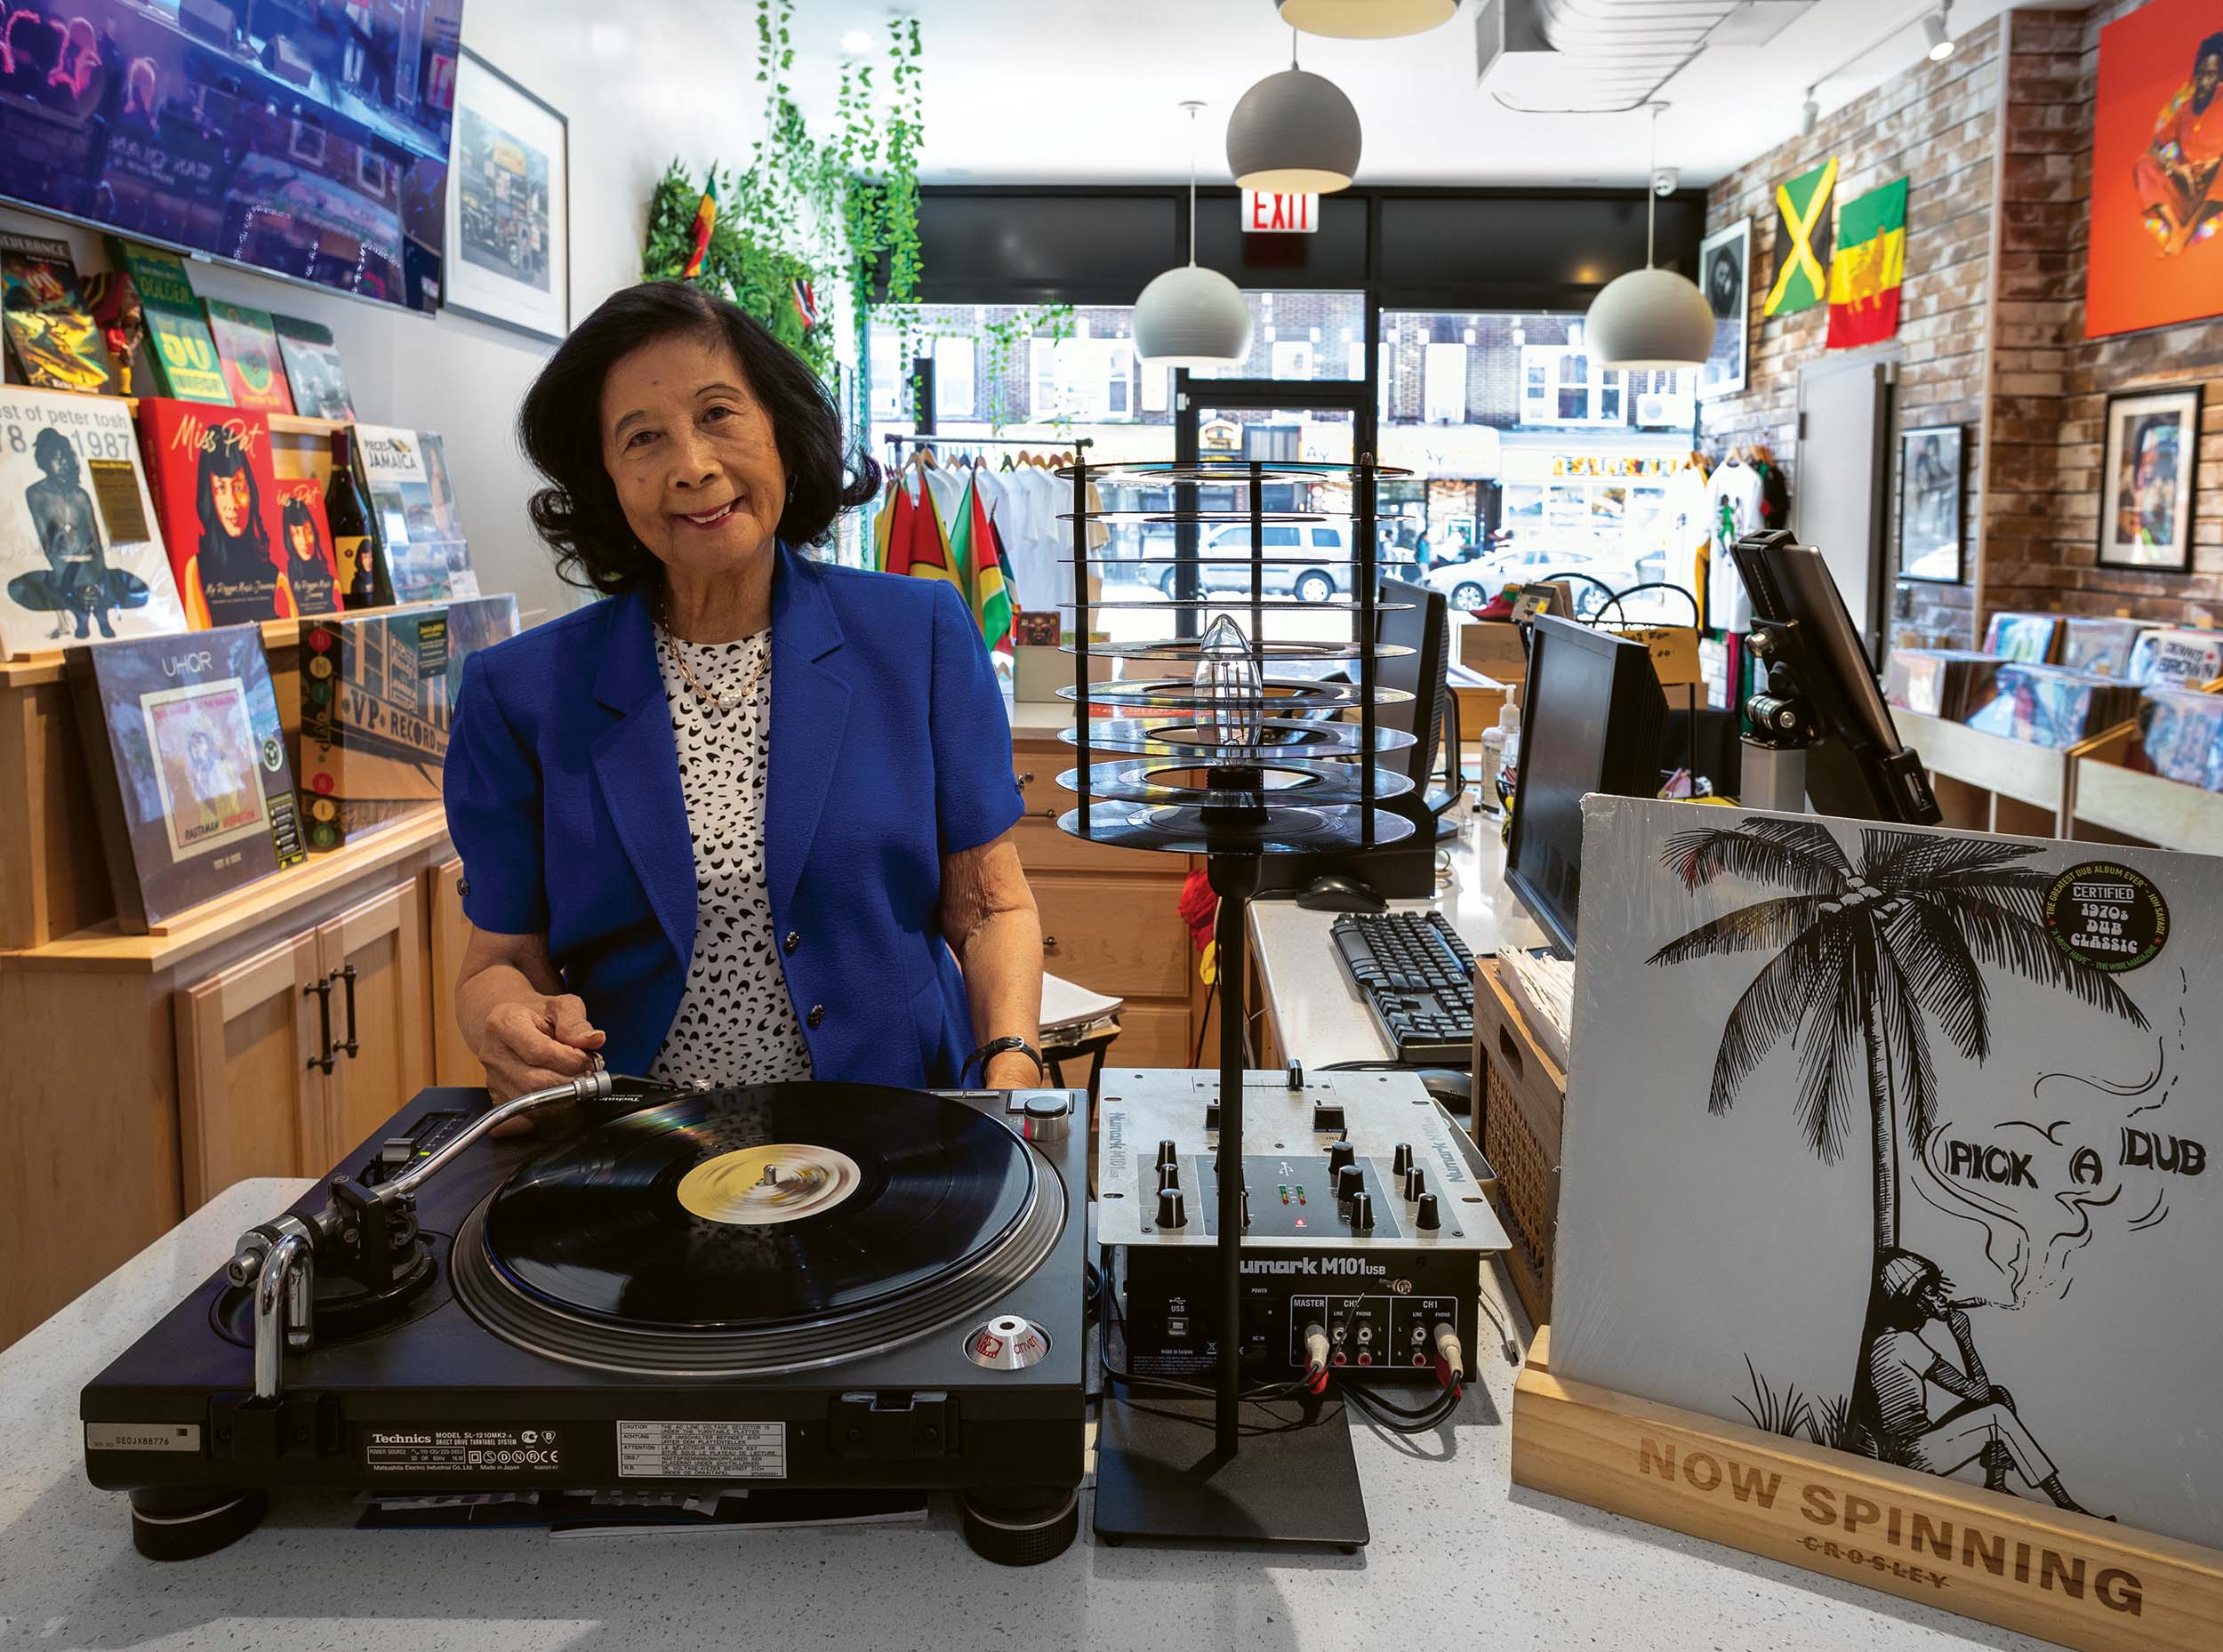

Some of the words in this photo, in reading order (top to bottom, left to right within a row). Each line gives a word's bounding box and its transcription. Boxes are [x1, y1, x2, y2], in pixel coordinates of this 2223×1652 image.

[1253, 191, 1306, 229] EXIT
[25, 405, 42, 421] of
[47, 408, 88, 425] peter
[93, 412, 127, 428] tosh
[71, 429, 130, 460] 1987
[171, 413, 217, 461] Miss
[222, 418, 264, 458] Pat
[369, 453, 418, 470] JAMAICA
[390, 710, 437, 750] RECORD
[2075, 866, 2092, 878] DUB
[2094, 865, 2123, 878] ALBUM
[2073, 886, 2135, 900] CERTIFIED
[2081, 902, 2129, 921] 1970s
[2086, 918, 2123, 936] DUB
[2070, 933, 2138, 954] CLASSIC
[1945, 1140, 2039, 1190] PICK
[2069, 1146, 2103, 1186] A
[2121, 1127, 2207, 1176] DUB
[1240, 1257, 1318, 1275] umark
[1294, 1300, 1325, 1308] MASTER
[1423, 1301, 1438, 1309] CH1
[373, 1433, 431, 1444] Technics
[1639, 1436, 1783, 1510] NOW
[1799, 1484, 2144, 1618] SPINNING
[1800, 1536, 1950, 1590] CROSLEY
